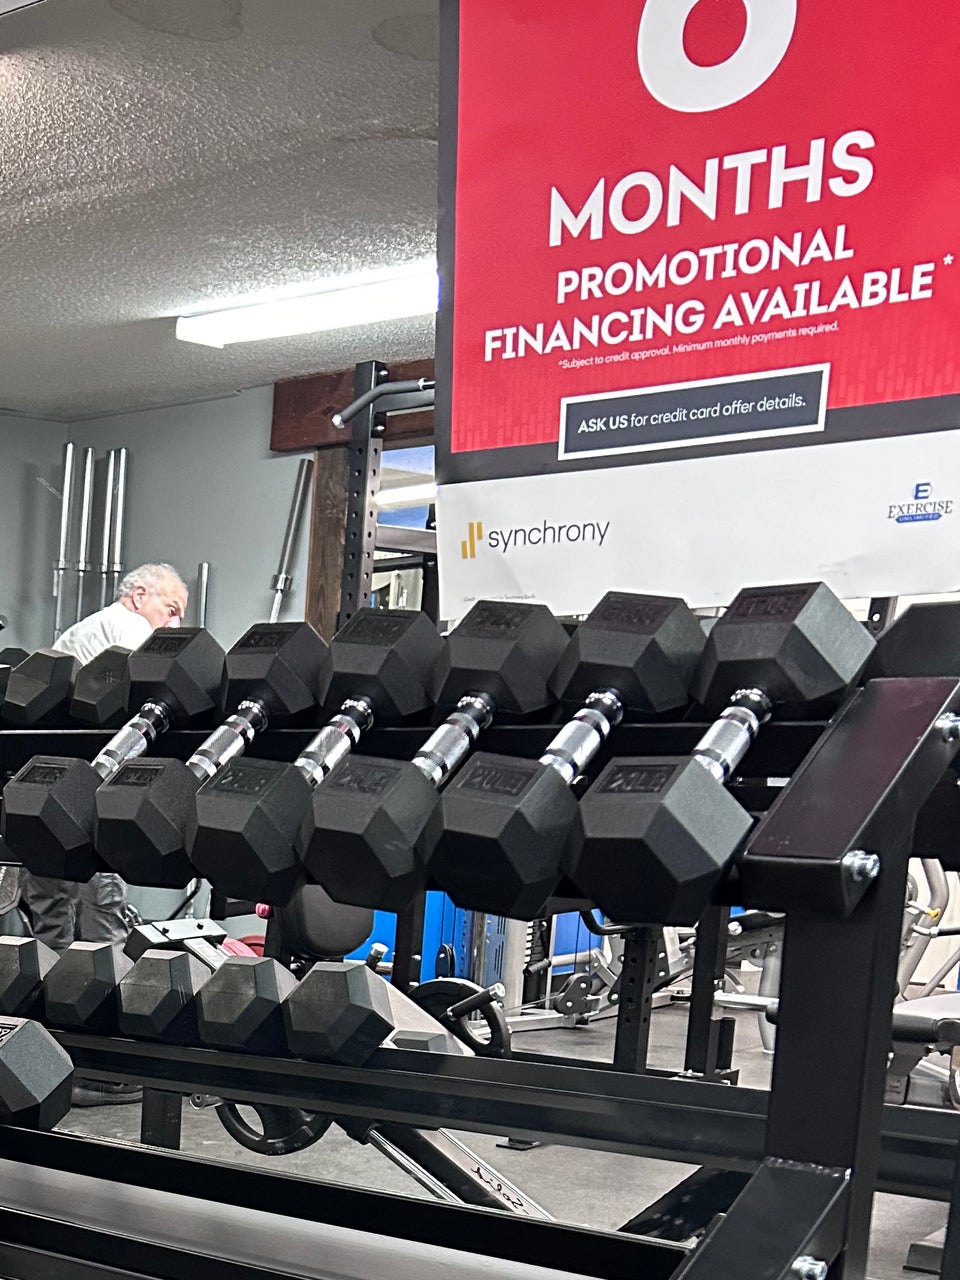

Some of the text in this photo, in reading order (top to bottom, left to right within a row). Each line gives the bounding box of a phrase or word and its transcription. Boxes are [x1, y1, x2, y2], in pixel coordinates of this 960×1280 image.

[549, 130, 876, 247] MONTHS
[557, 224, 854, 304] PROMOTIONAL
[484, 263, 936, 362] FINANCING AVAILABLE
[595, 356, 604, 365] to
[605, 351, 630, 364] credit
[631, 345, 671, 360] approval.
[672, 341, 714, 354] Minimum
[714, 334, 751, 349] monthly
[751, 328, 797, 345] payments
[798, 320, 840, 336] required.
[577, 393, 806, 433] ASK US for credit card offer details.
[887, 499, 953, 519] EXERCISE
[488, 520, 610, 553] synchrony
